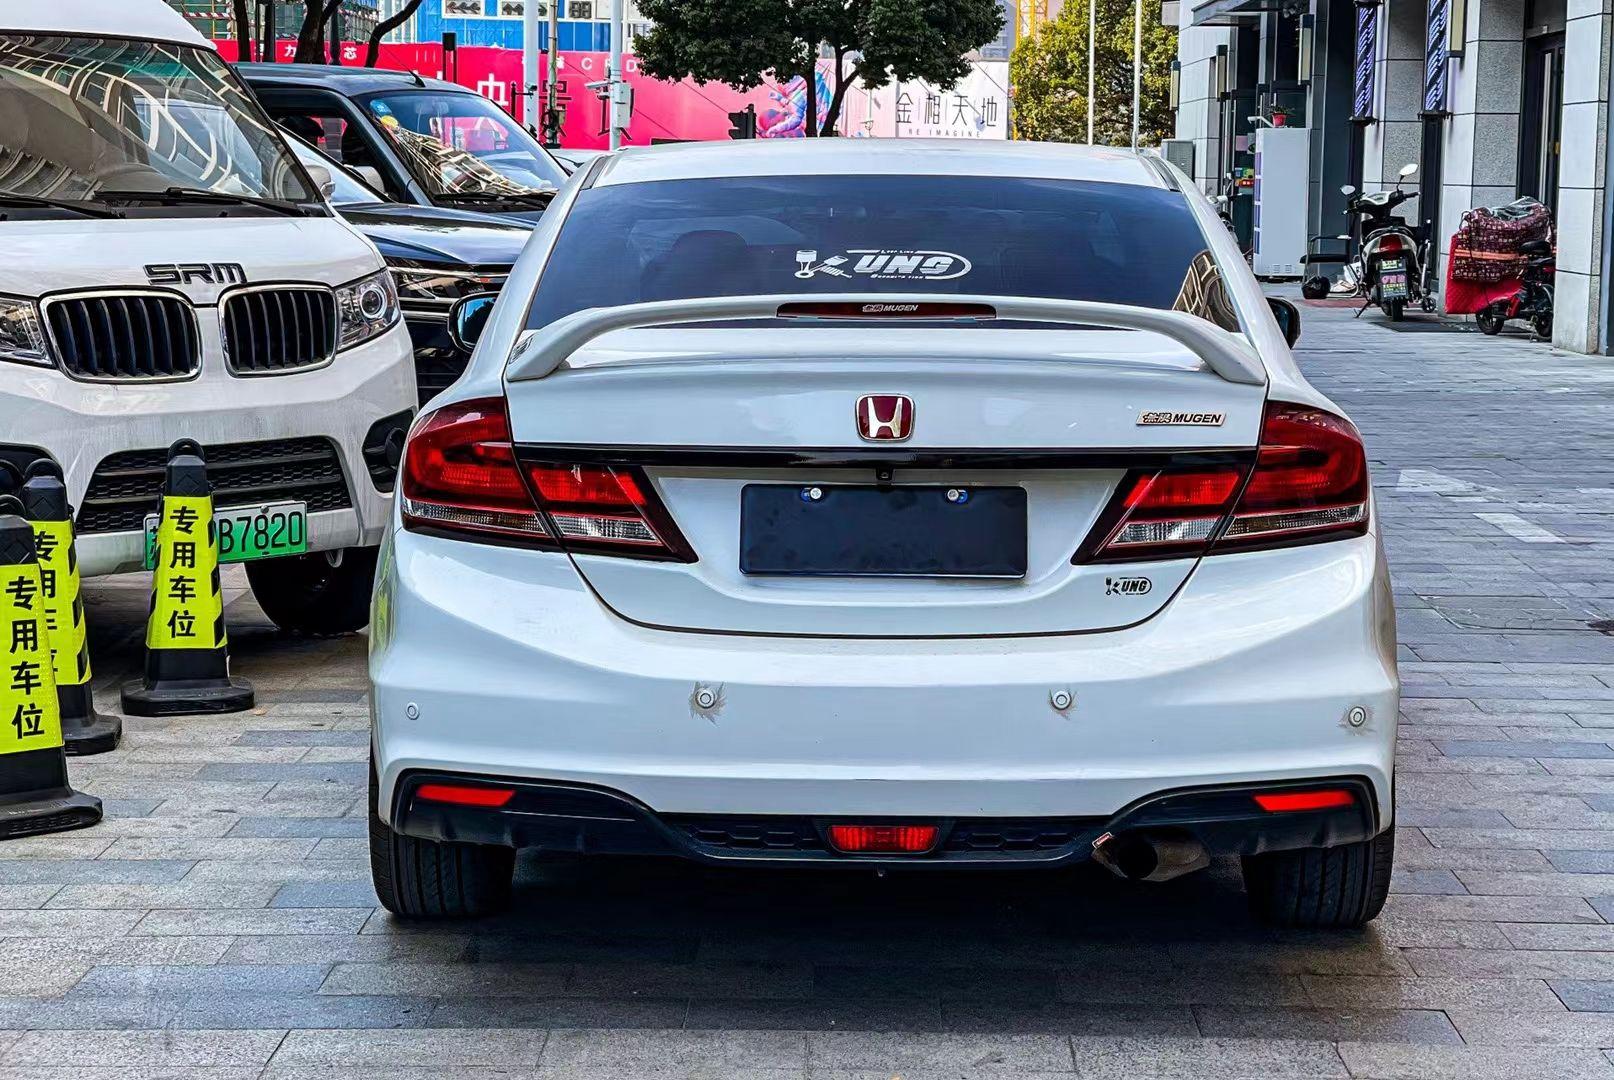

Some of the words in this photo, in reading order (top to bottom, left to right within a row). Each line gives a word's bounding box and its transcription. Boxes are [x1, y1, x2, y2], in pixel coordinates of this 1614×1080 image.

[143, 262, 248, 285] SRM
[883, 304, 919, 312] MUGEN
[1173, 413, 1222, 424] MUGEN
[167, 505, 200, 640] 专用车位
[5, 574, 46, 740] 专用车位
